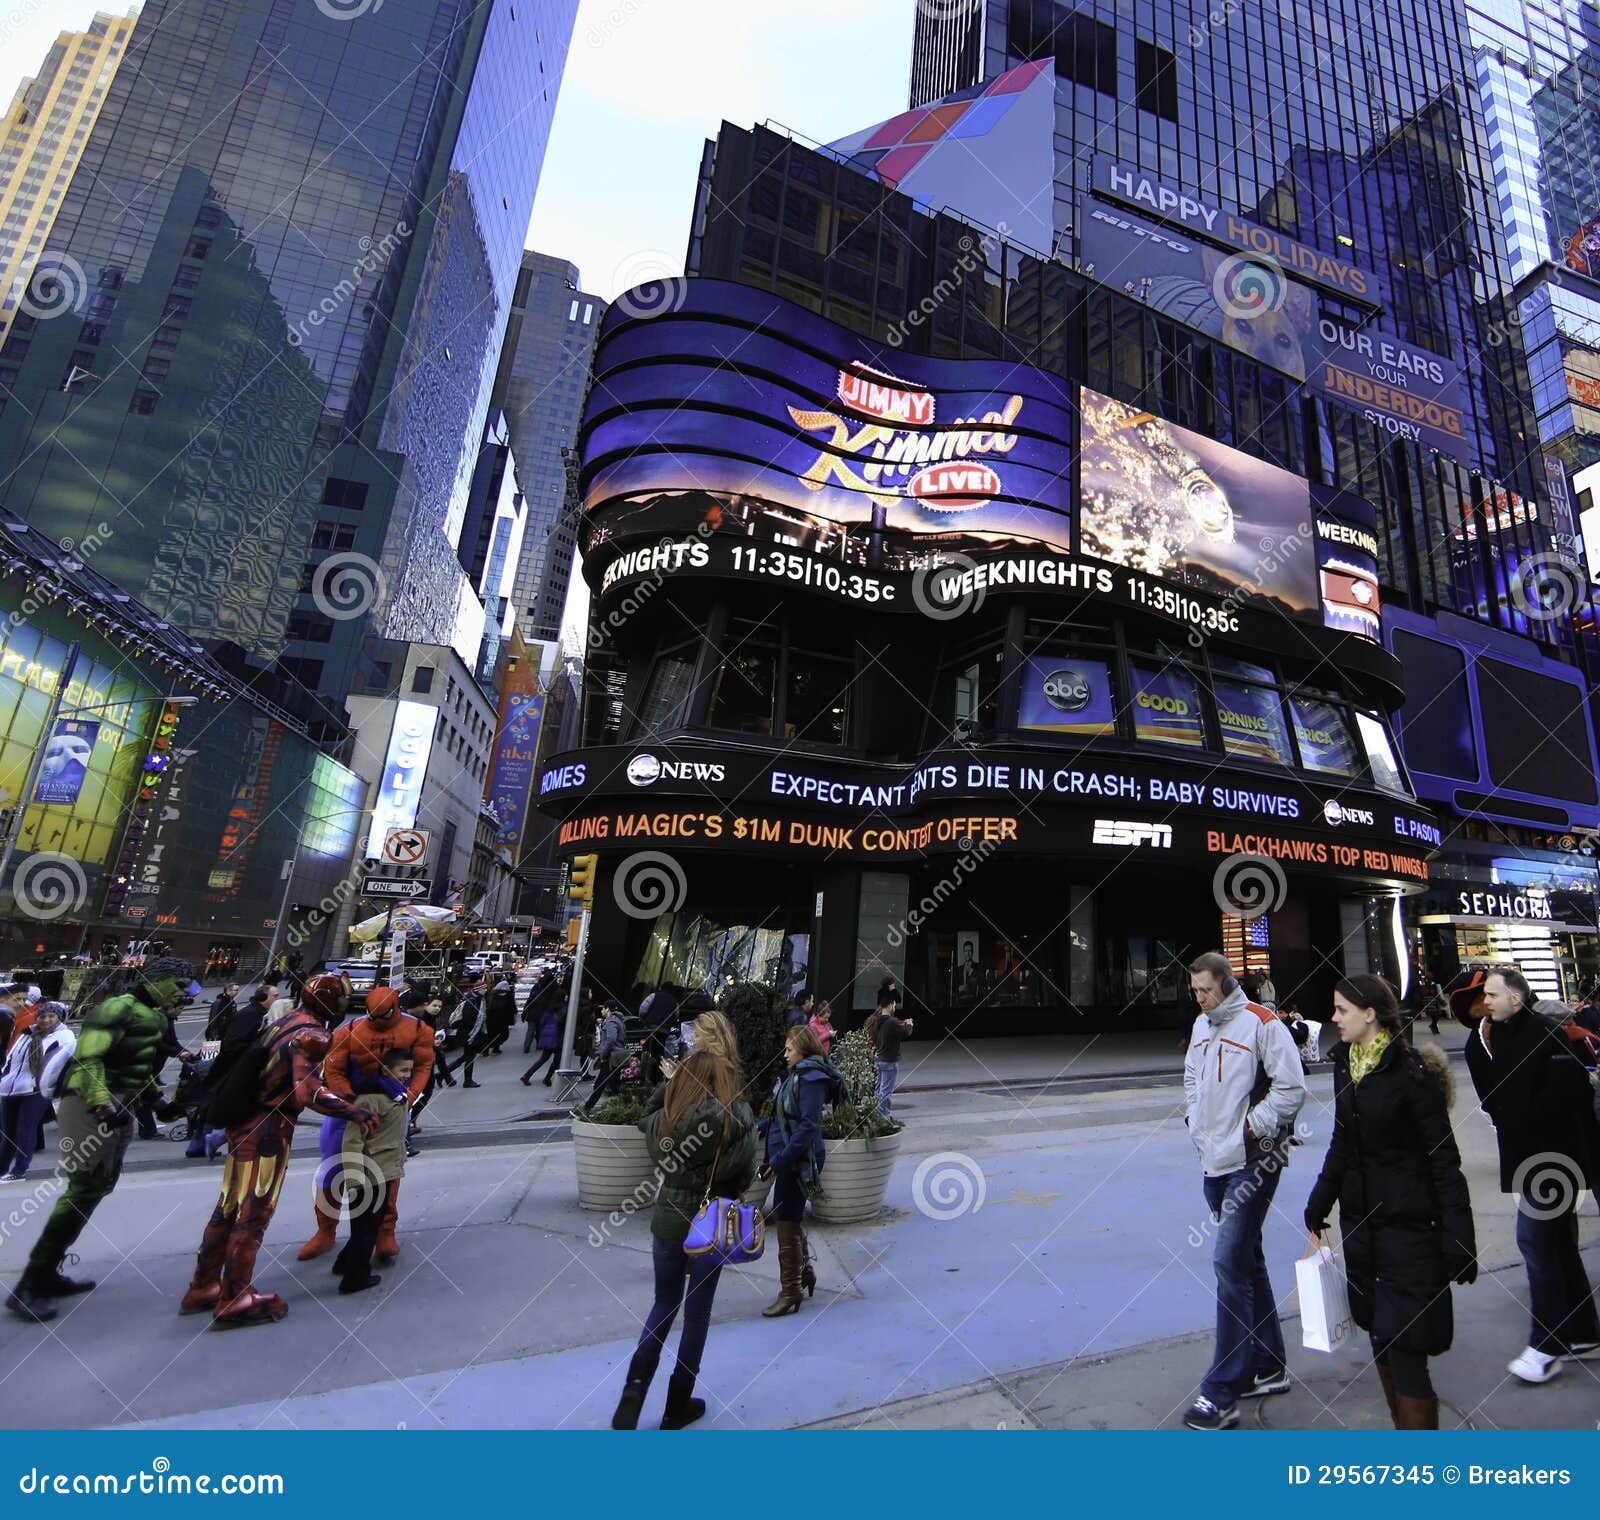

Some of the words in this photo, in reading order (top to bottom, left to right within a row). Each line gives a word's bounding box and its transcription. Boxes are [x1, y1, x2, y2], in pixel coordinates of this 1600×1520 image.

[1091, 210, 1192, 253] NITTO
[1110, 165, 1218, 231] HAPPY
[1227, 216, 1367, 293] HOLIDAYS
[1319, 319, 1373, 358] OUR
[1380, 342, 1444, 385] EARS
[1366, 361, 1408, 388] YOUR
[846, 373, 929, 420] JIMMY
[1364, 409, 1421, 441] STORY
[787, 395, 1023, 508] Kimmel
[920, 470, 993, 493] LIVE!
[940, 559, 1113, 601] WEEKNIGHTS
[1042, 678, 1089, 699] abc
[1136, 691, 1189, 716] GOOD
[1218, 709, 1268, 731] ORNING
[660, 761, 725, 782] NEWS
[771, 771, 906, 807] EXPECTANT
[967, 765, 1010, 789] DIE
[1020, 767, 1044, 791] IN
[1053, 770, 1142, 802] CRASH;
[1149, 779, 1205, 805] BABY
[1212, 787, 1300, 818] SURVIVES
[1342, 808, 1374, 826] NEWS
[1394, 816, 1408, 836] EL
[615, 813, 723, 838] MAGIC'S
[732, 817, 781, 842] $1M
[789, 822, 853, 850] DUNK
[937, 817, 1018, 841] OFFER
[1092, 819, 1173, 849] ESPN
[1207, 830, 1327, 863] BLACKHAWKS
[1331, 844, 1360, 867] TOP
[1363, 852, 1389, 871] RED
[372, 883, 393, 891] ONE
[401, 884, 421, 893] WAY
[1460, 891, 1552, 919] SEPHORA
